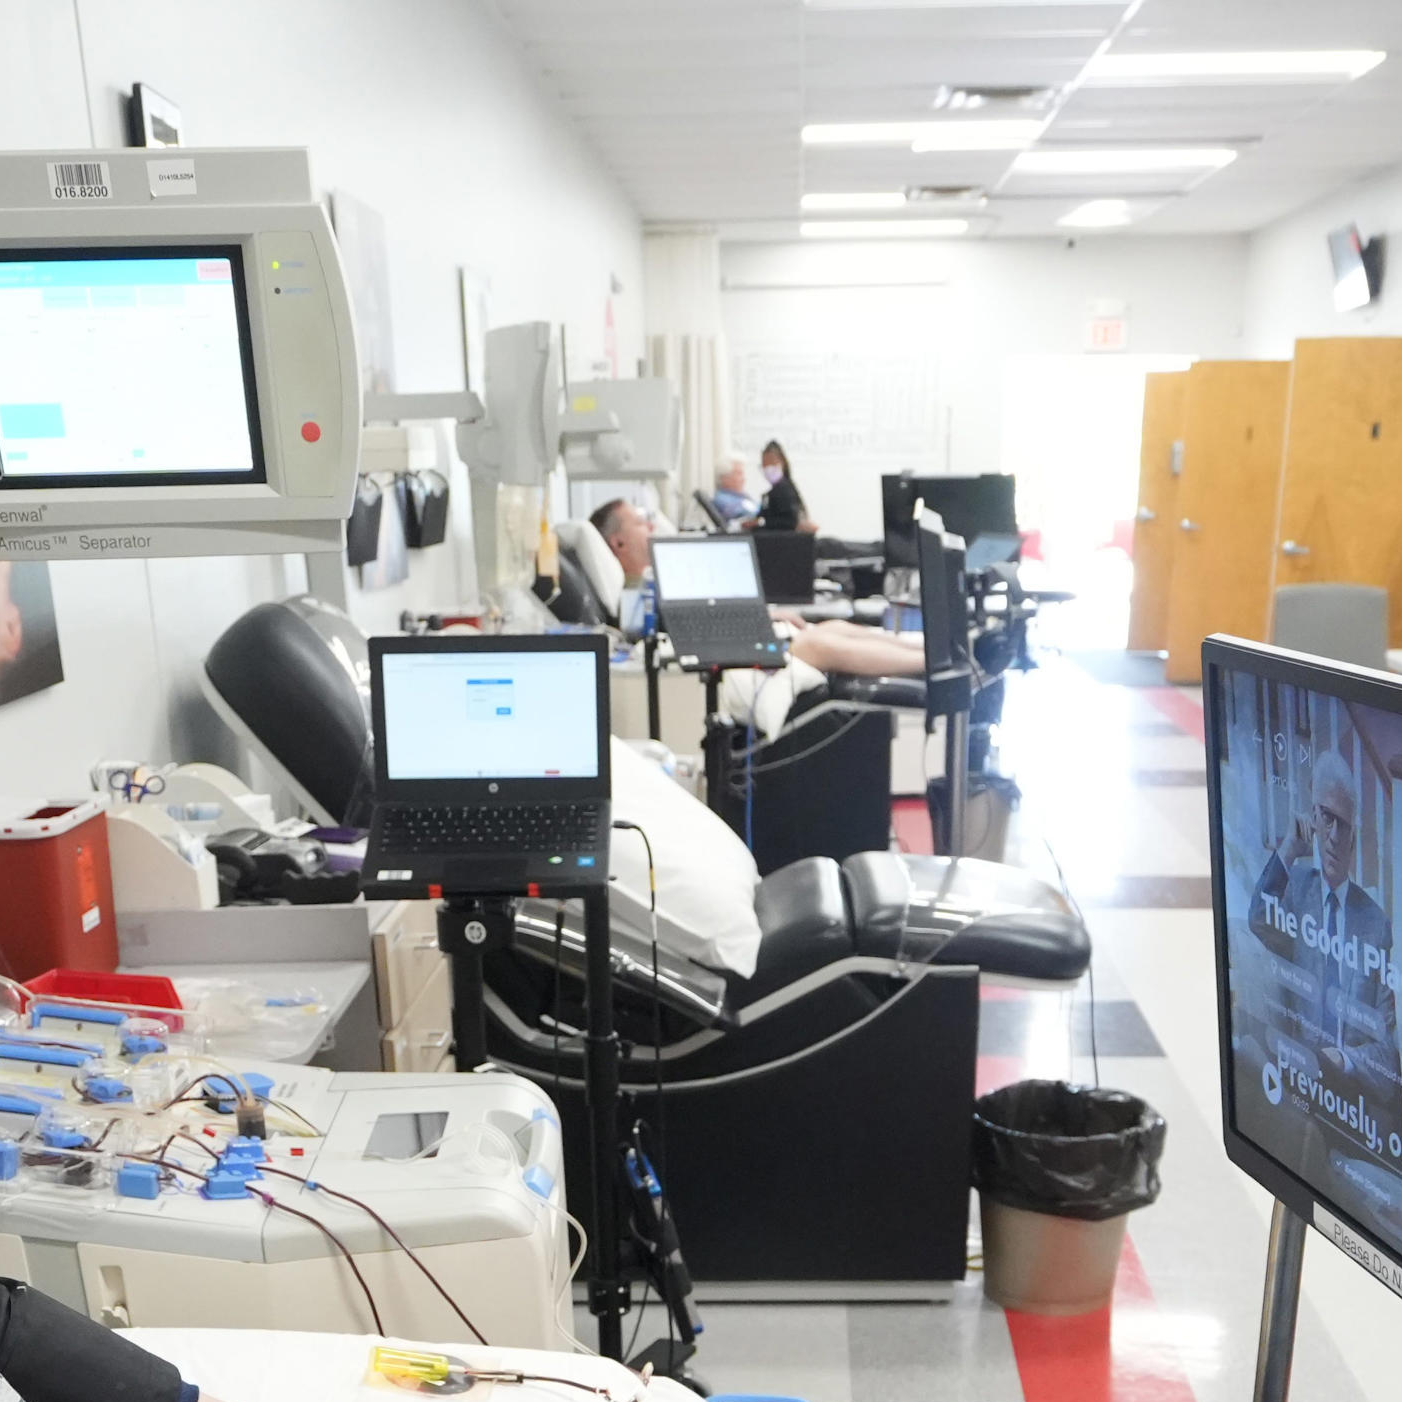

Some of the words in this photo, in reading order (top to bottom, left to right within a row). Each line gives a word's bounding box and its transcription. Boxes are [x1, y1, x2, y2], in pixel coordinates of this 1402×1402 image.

[55, 186, 108, 198] 016.8200
[79, 535, 151, 551] Separator
[1261, 890, 1298, 939] The
[1301, 914, 1359, 971] Good
[1278, 1040, 1383, 1154] Previously,
[1333, 1222, 1370, 1266] Please
[1373, 1254, 1389, 1281] Do
